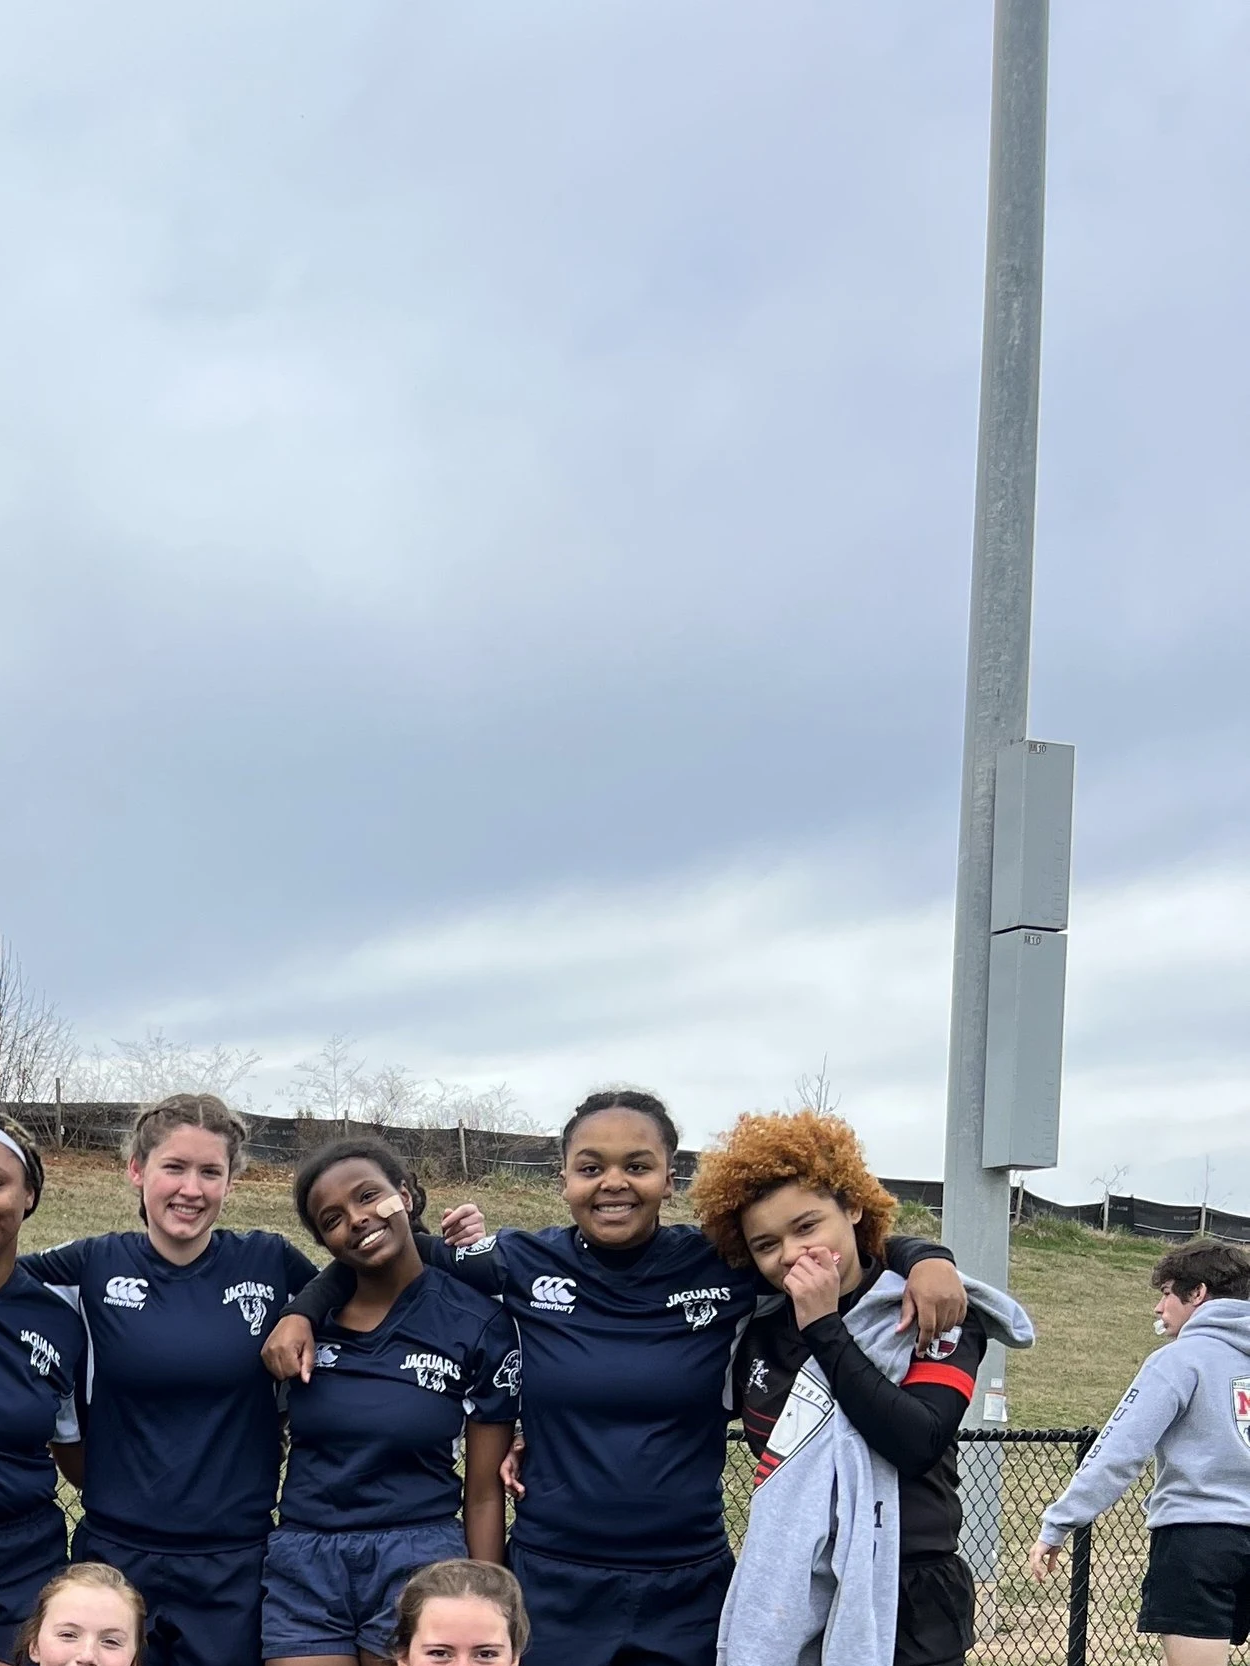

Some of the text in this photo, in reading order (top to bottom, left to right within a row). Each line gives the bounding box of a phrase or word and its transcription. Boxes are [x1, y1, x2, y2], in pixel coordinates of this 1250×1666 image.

[222, 1281, 275, 1305] JAGUARS
[666, 1287, 731, 1308] JAGUARS
[530, 1301, 576, 1315] canterbury
[20, 1329, 61, 1368] JAGUARS
[399, 1353, 461, 1381] JAGUARS
[1075, 1388, 1140, 1476] RUGBY
